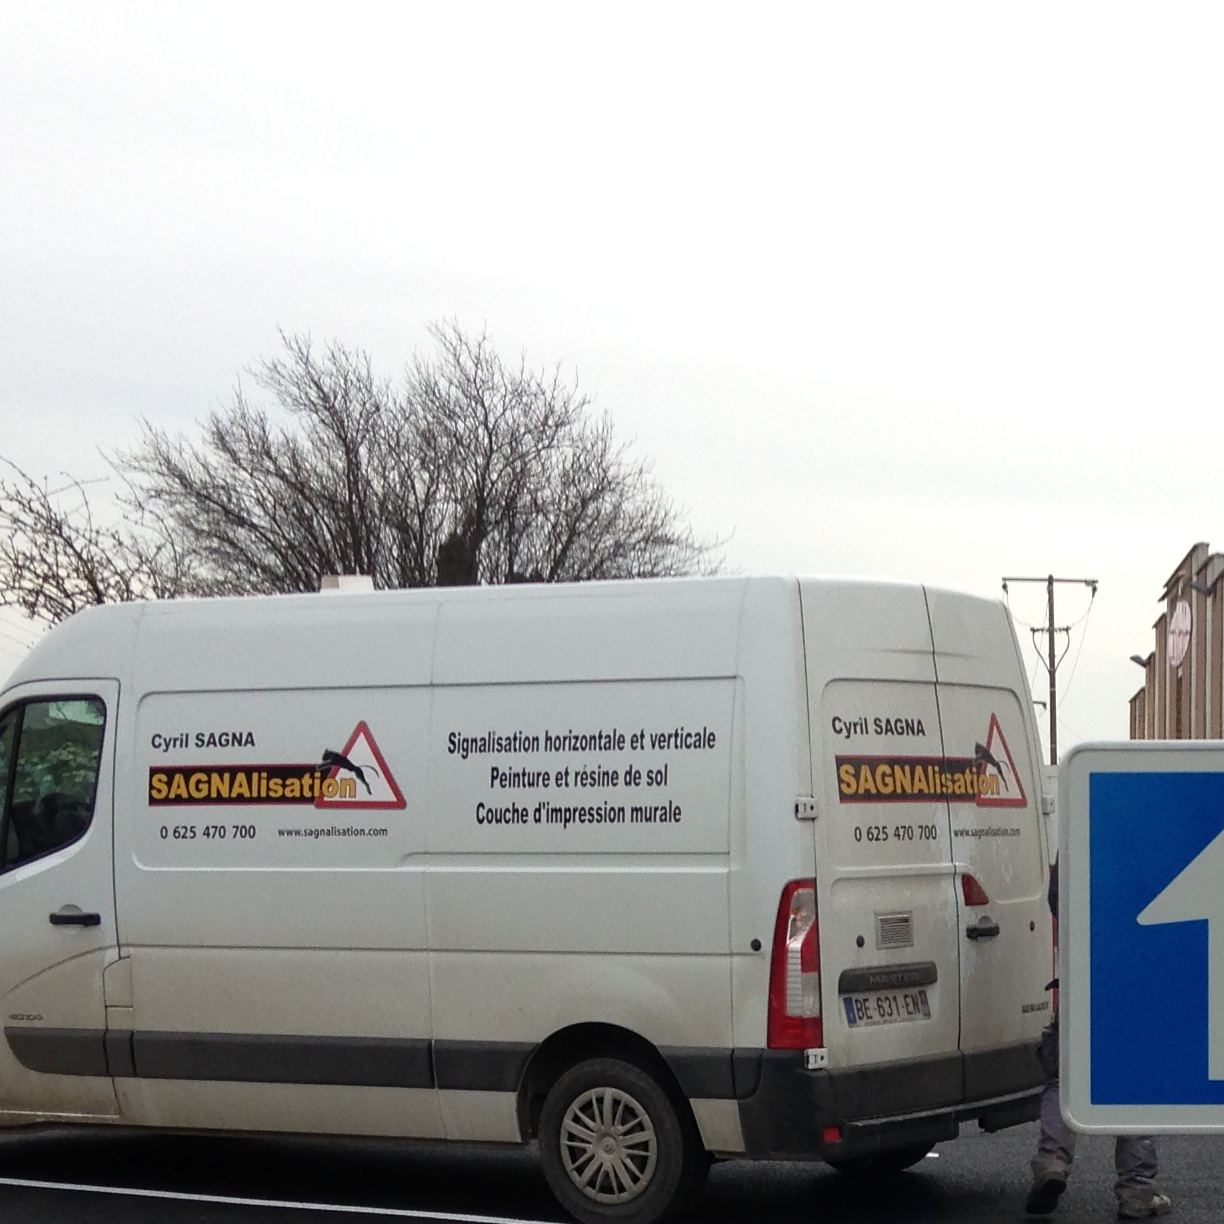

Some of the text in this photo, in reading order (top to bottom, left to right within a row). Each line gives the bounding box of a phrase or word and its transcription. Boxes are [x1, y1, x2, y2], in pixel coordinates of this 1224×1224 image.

[831, 716, 927, 739] Cyril SAGNA
[151, 732, 256, 752] Cyril SAGNA
[447, 726, 716, 760] Signalisation horizontale et verticale
[150, 771, 357, 799] SAGNAlisation
[490, 763, 669, 789] Peinture et résine de sol
[838, 763, 1001, 797] SAGNAlisation
[475, 800, 682, 830] Couche d'impression murale
[172, 825, 197, 840] 625
[202, 825, 227, 839] 470
[232, 825, 256, 839] 700
[277, 826, 389, 839] www.sagnalisation.com
[866, 826, 889, 842] 625
[893, 825, 914, 841] 470
[918, 824, 937, 841] 700
